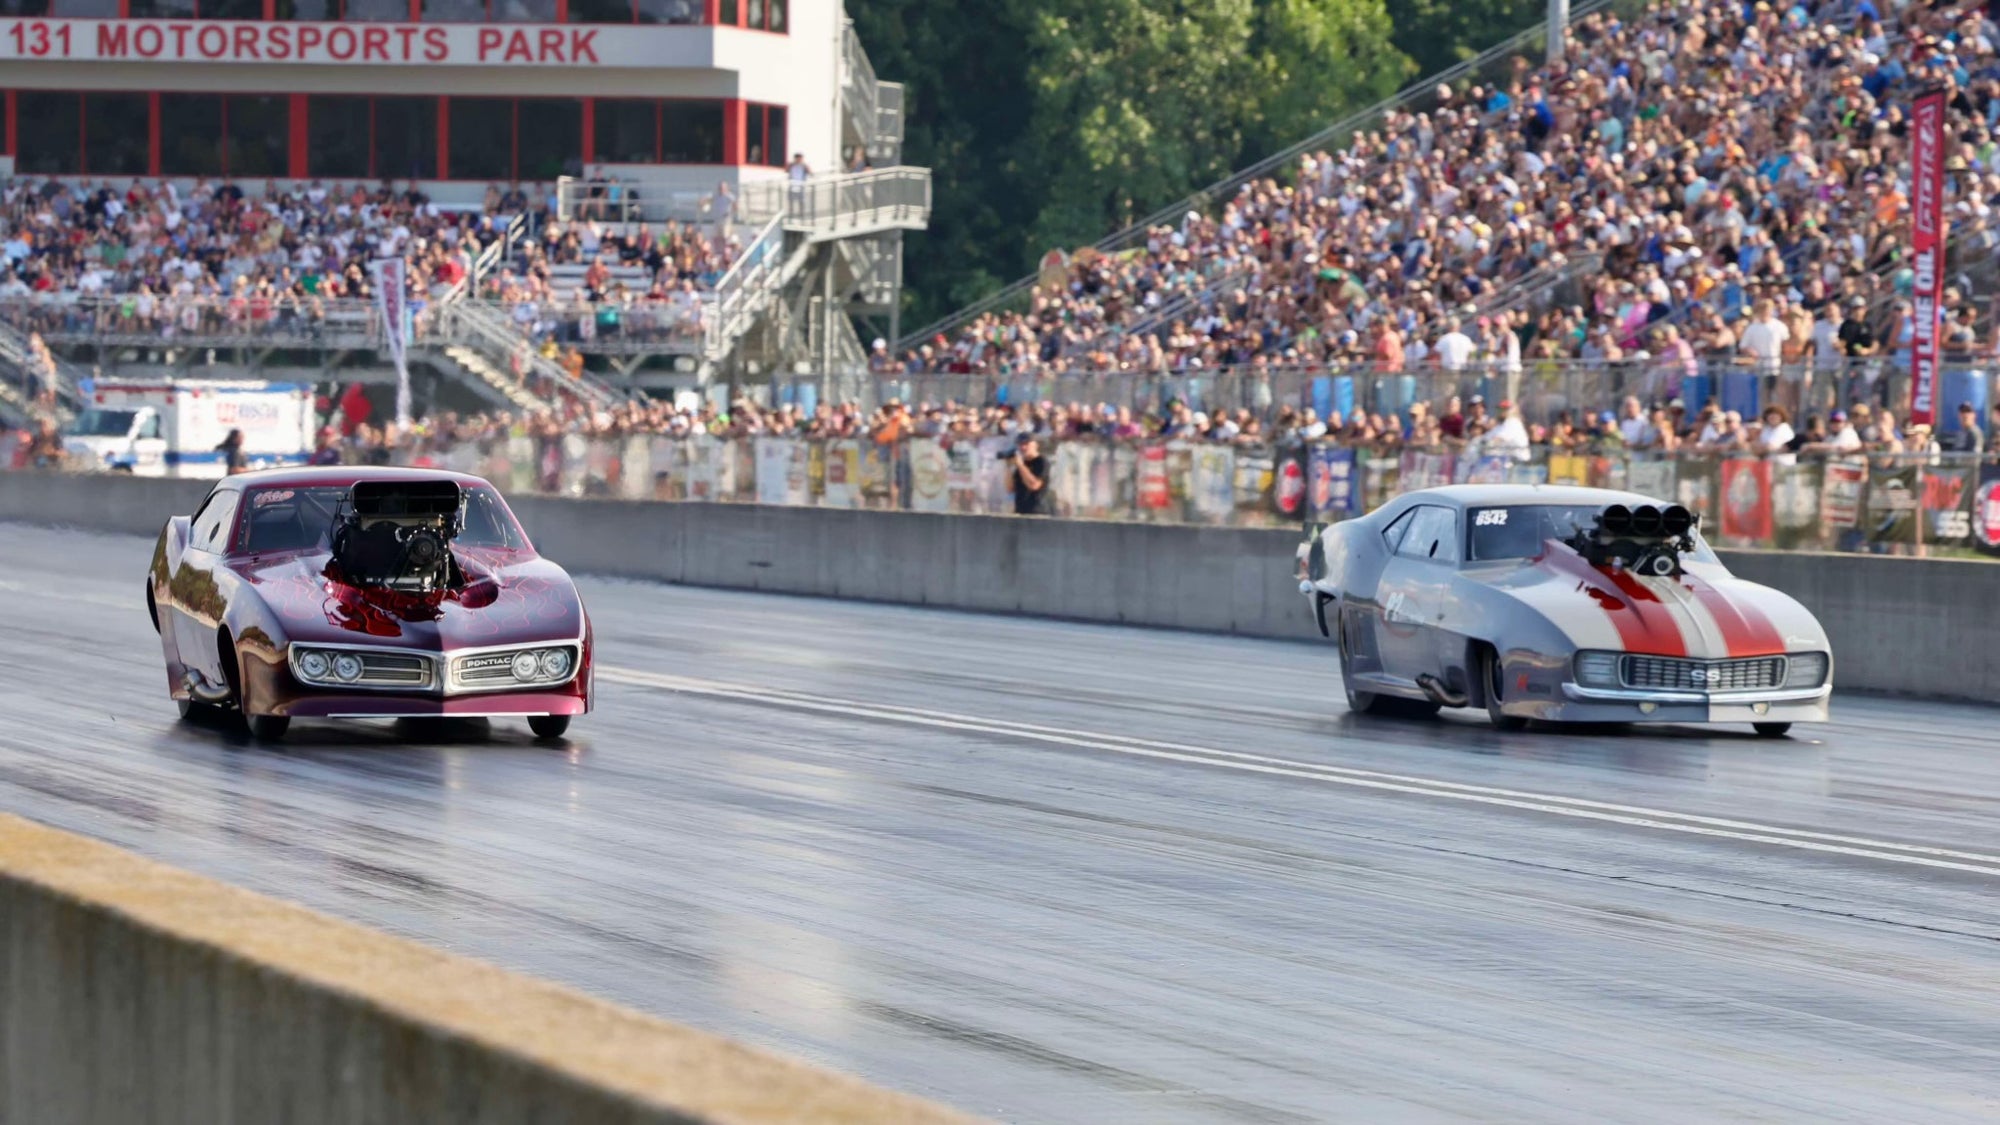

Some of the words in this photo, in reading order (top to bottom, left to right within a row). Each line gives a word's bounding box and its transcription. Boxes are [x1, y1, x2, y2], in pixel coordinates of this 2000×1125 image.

[9, 22, 70, 55] 131
[97, 24, 450, 60] MOTORSPORTS
[478, 29, 599, 64] PARK
[1916, 247, 1935, 290] OIL
[1915, 295, 1935, 354] LINE
[466, 657, 511, 668] PONTIAC
[1690, 669, 1721, 681] SS
